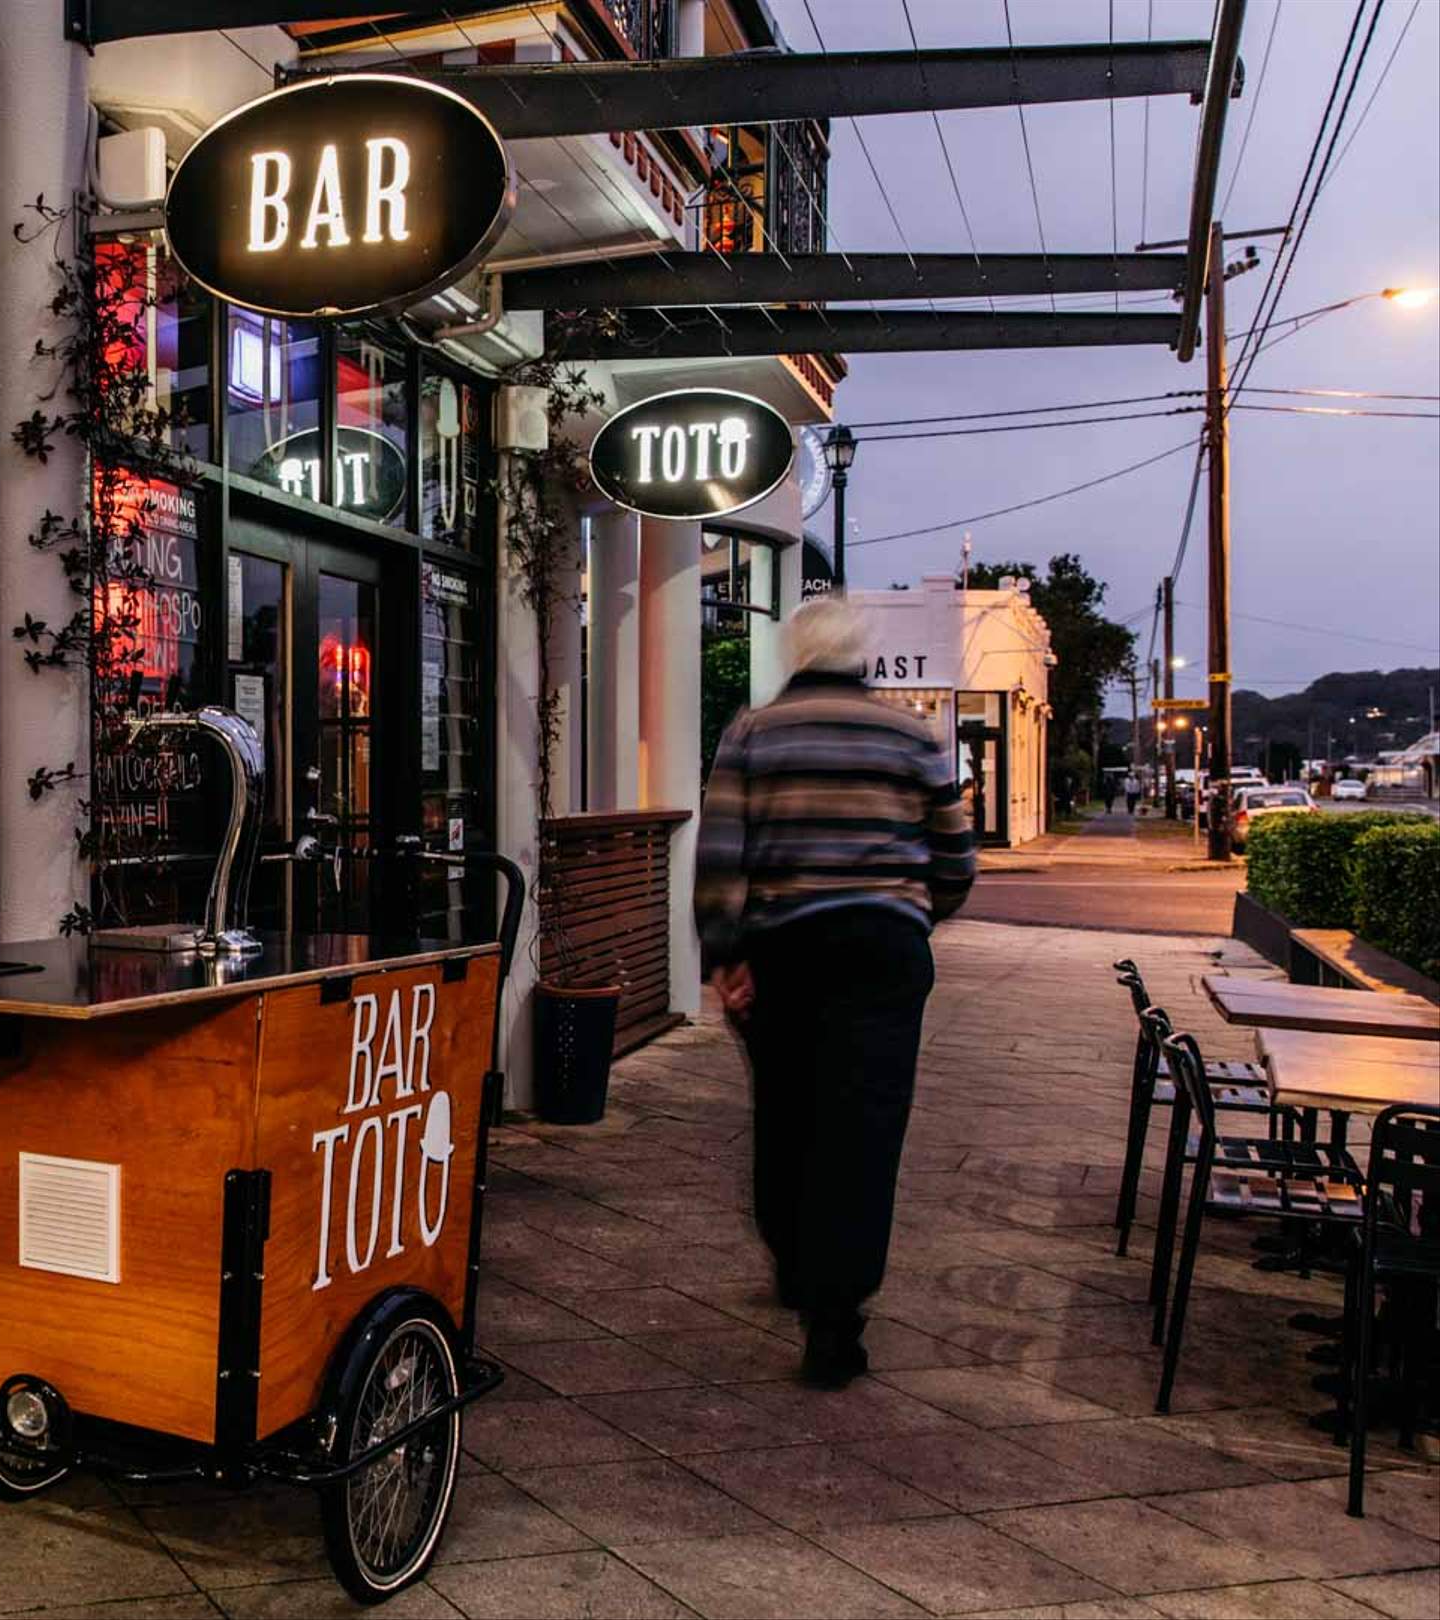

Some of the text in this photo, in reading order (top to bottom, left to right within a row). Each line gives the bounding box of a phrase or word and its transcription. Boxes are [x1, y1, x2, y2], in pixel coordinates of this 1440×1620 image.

[247, 137, 411, 252] BAR
[631, 417, 752, 484] TOTO
[343, 983, 436, 1115] BAR
[311, 1091, 455, 1292] TOTO
